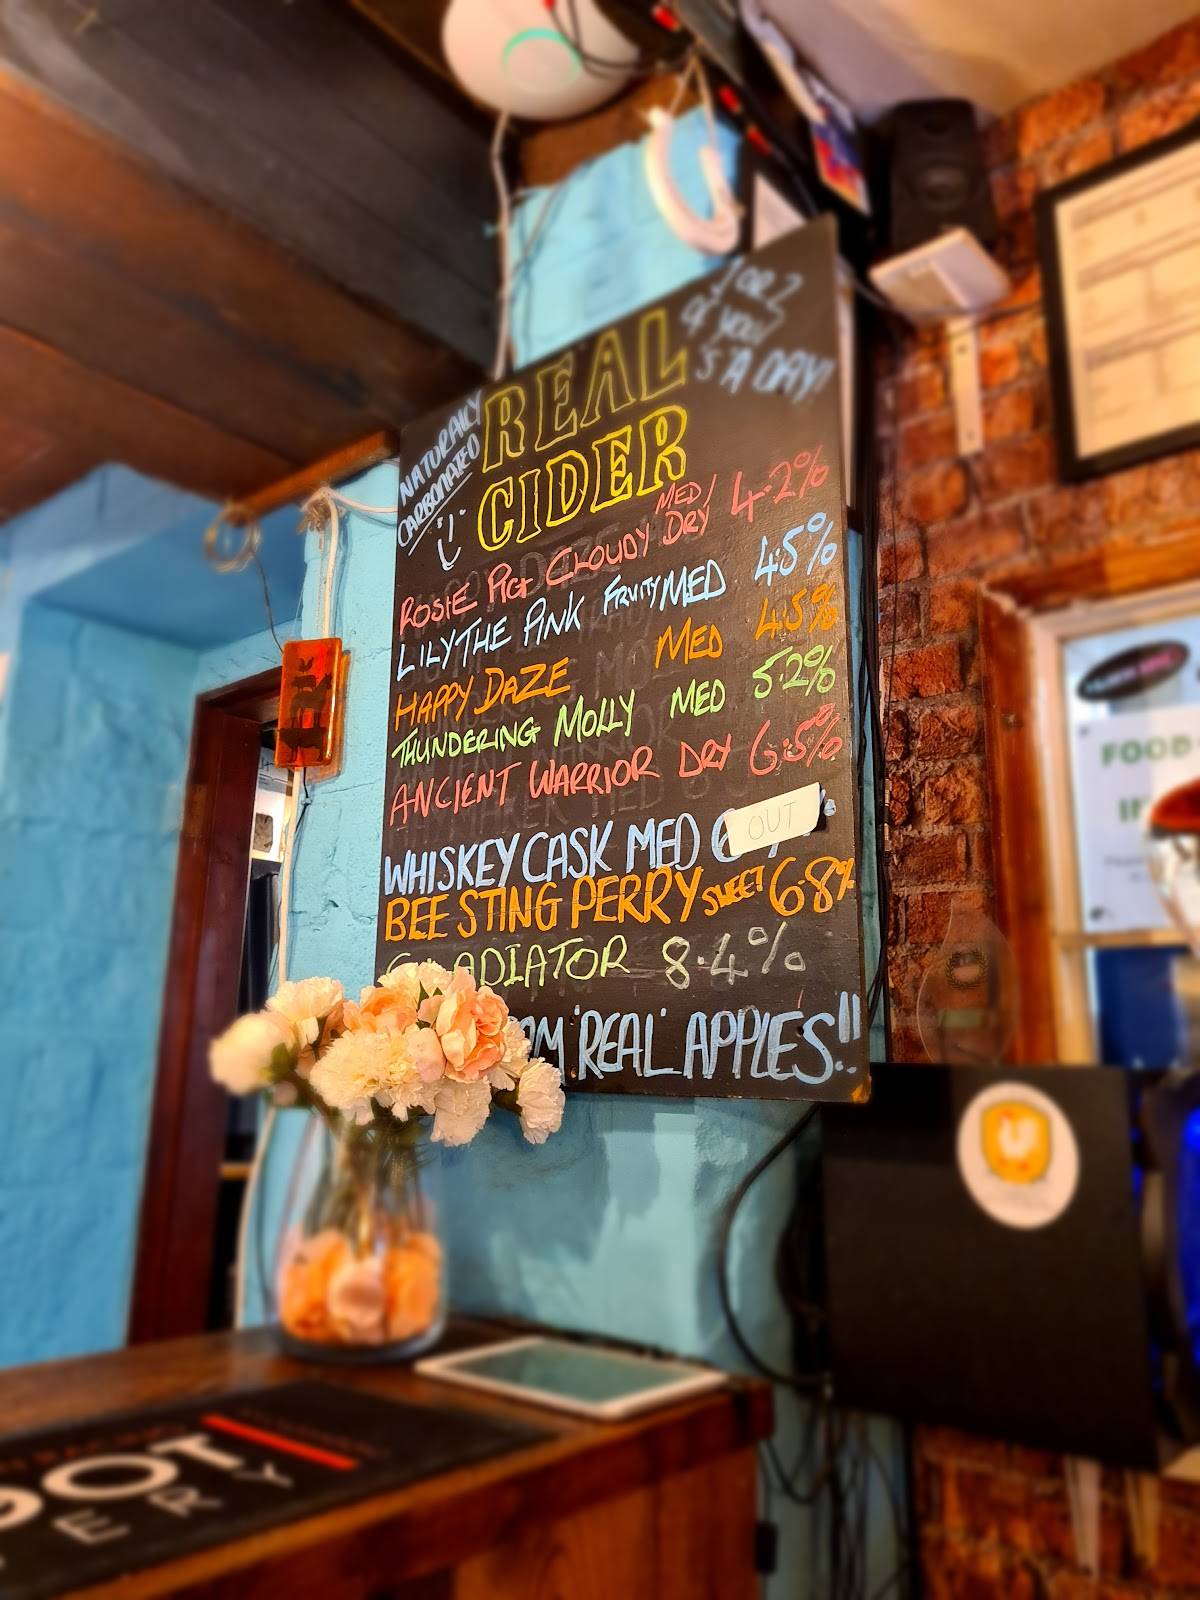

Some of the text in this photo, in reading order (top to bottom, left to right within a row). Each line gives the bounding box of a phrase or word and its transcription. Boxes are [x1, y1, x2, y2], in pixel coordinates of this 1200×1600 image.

[480, 307, 690, 474] REAL
[720, 348, 752, 395] A
[476, 404, 690, 552] CIDER
[399, 582, 479, 637] ROSIE
[546, 522, 651, 587] CLOUDY
[662, 505, 711, 547] DRY
[730, 444, 831, 524] 4.2%
[523, 590, 586, 648] PINK
[603, 573, 662, 617] FRUITY
[659, 558, 728, 613] MED
[754, 512, 838, 588] 4.5%
[391, 645, 837, 769] THUNDERING MOLLY MED 5.2%
[395, 583, 838, 732] HAPPY DAZE MED 4.5%
[388, 703, 844, 827] ANCIENT WARRIOR DRY 6.5%
[748, 801, 798, 842] OUT
[384, 831, 521, 896] WHISKEY
[521, 820, 615, 885] CASK
[625, 812, 702, 874] MED
[384, 893, 449, 943] BEE
[457, 881, 564, 940] STING
[570, 865, 704, 930] PERRY
[702, 865, 766, 918] SWEET
[661, 921, 808, 991] 8.4%
